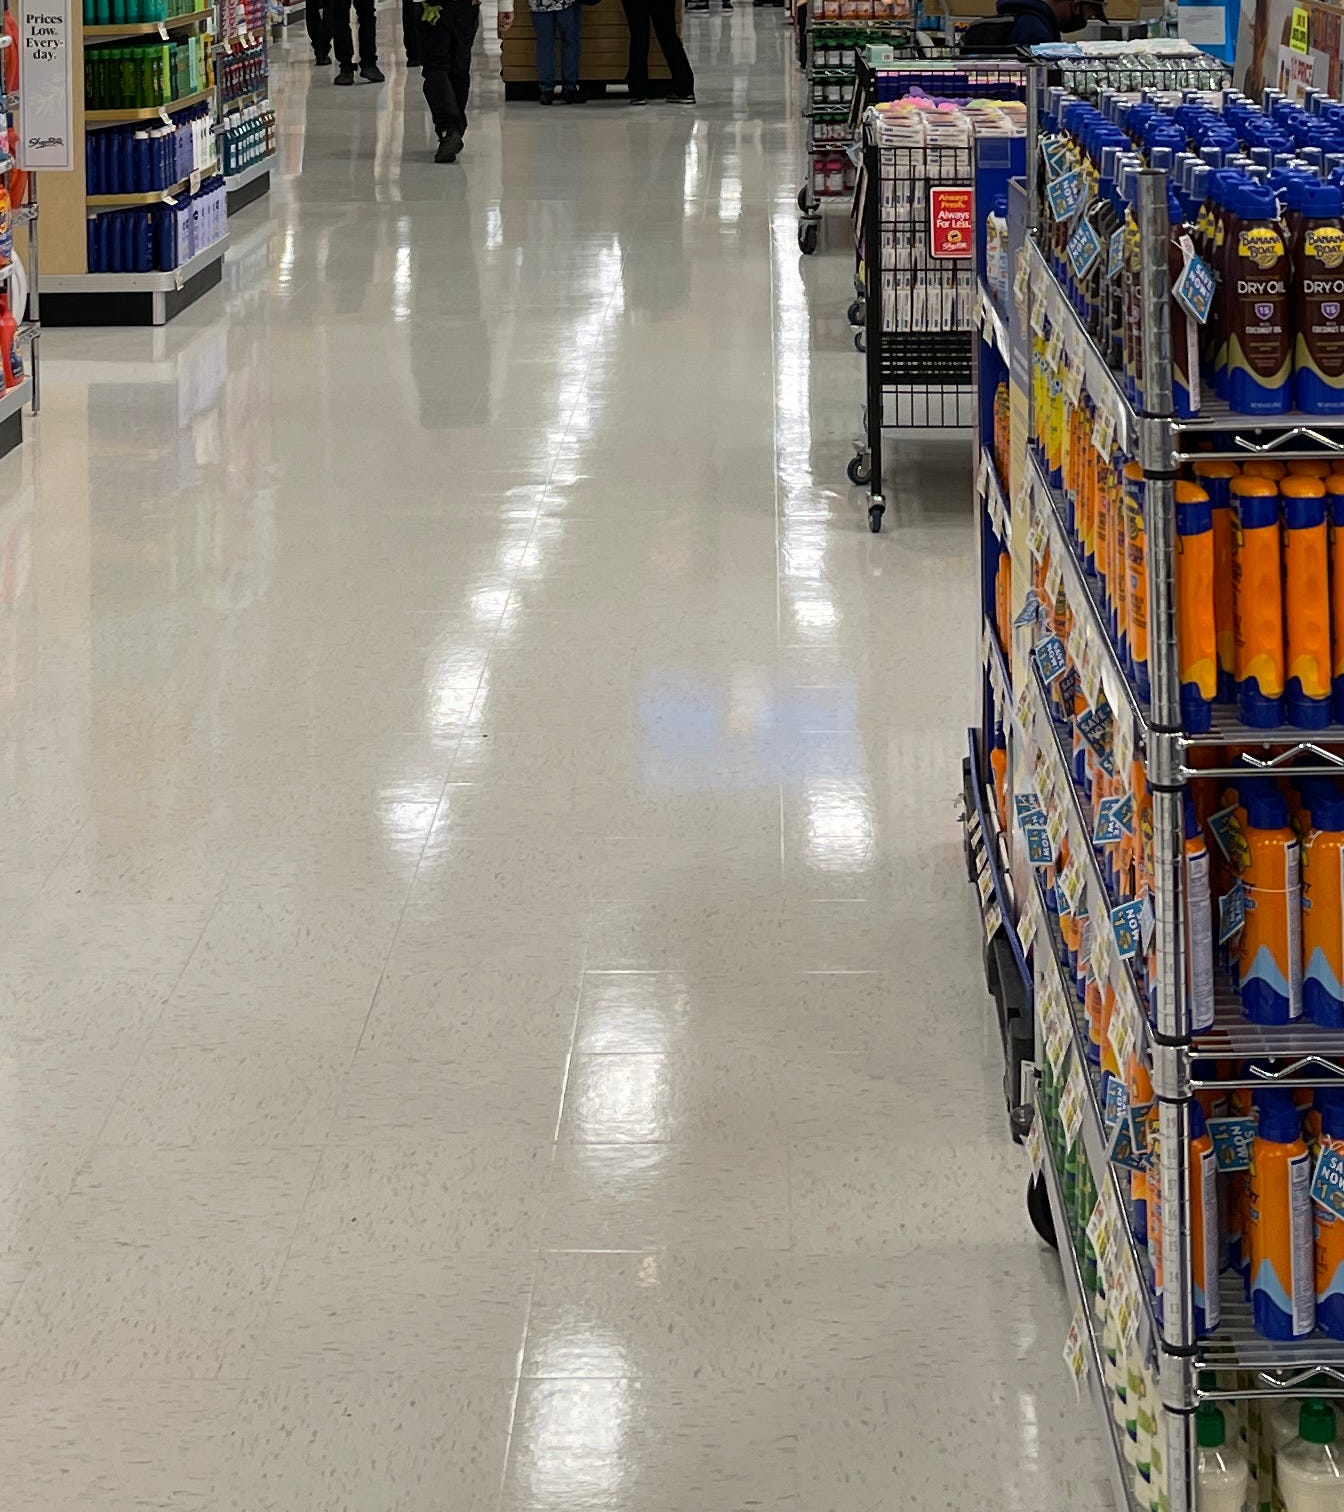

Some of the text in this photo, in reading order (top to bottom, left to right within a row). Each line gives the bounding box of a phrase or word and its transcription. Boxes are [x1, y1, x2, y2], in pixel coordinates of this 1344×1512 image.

[26, 13, 64, 24] Prices
[30, 25, 58, 37] Low.
[26, 37, 64, 51] Every-
[32, 48, 57, 61] day.
[938, 210, 970, 221] Always
[936, 219, 951, 228] For
[1239, 234, 1284, 247] BANANA
[1247, 244, 1276, 257] BOAT
[1314, 243, 1343, 256] BOAT
[1237, 280, 1286, 294] DRY OIL
[1304, 280, 1333, 294] DRY
